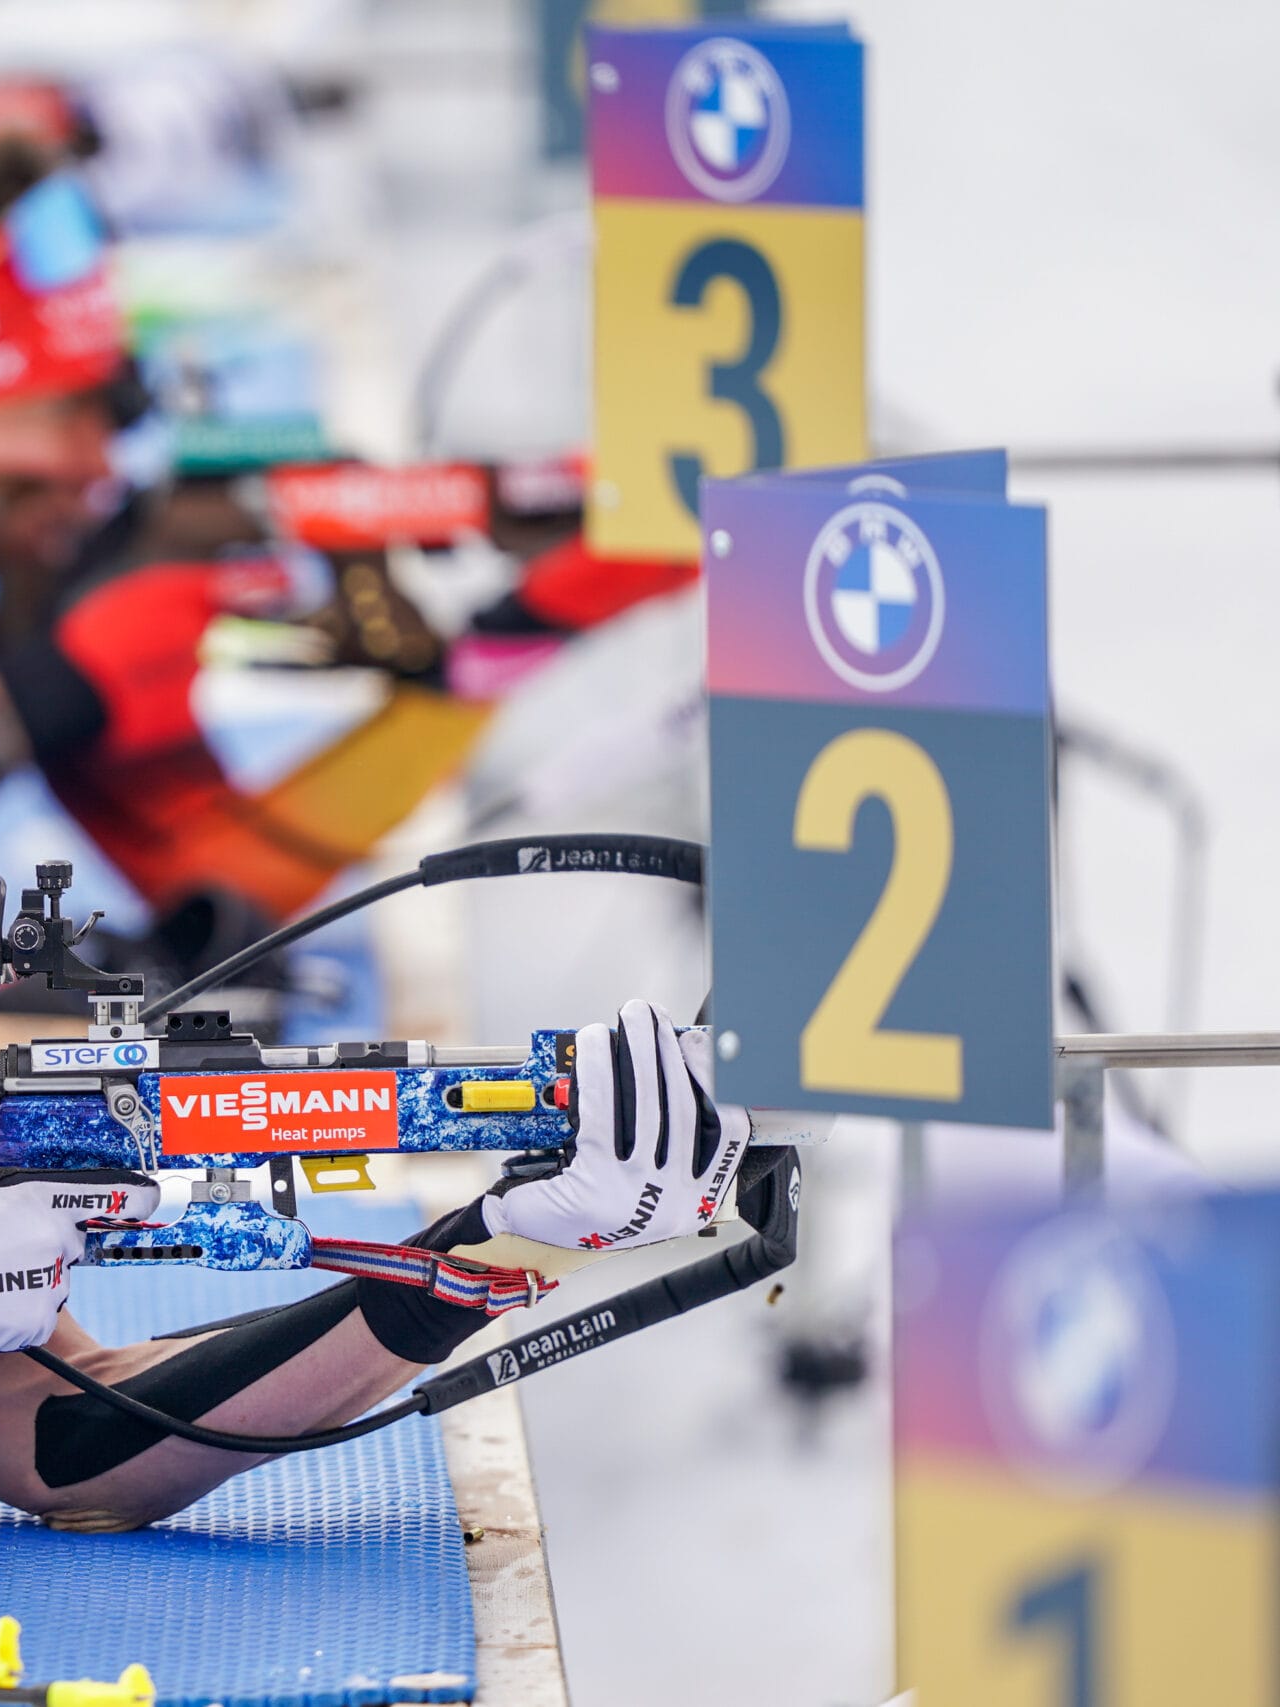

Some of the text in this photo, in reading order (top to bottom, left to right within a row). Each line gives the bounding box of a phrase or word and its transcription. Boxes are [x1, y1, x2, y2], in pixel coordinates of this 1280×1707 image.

[667, 236, 787, 532] 3
[793, 727, 963, 1102] 2
[44, 1047, 111, 1066] STEF
[166, 1081, 391, 1132] VIESSMANN
[271, 1126, 366, 1143] Heat pumps
[520, 1309, 617, 1365] Jean Lain
